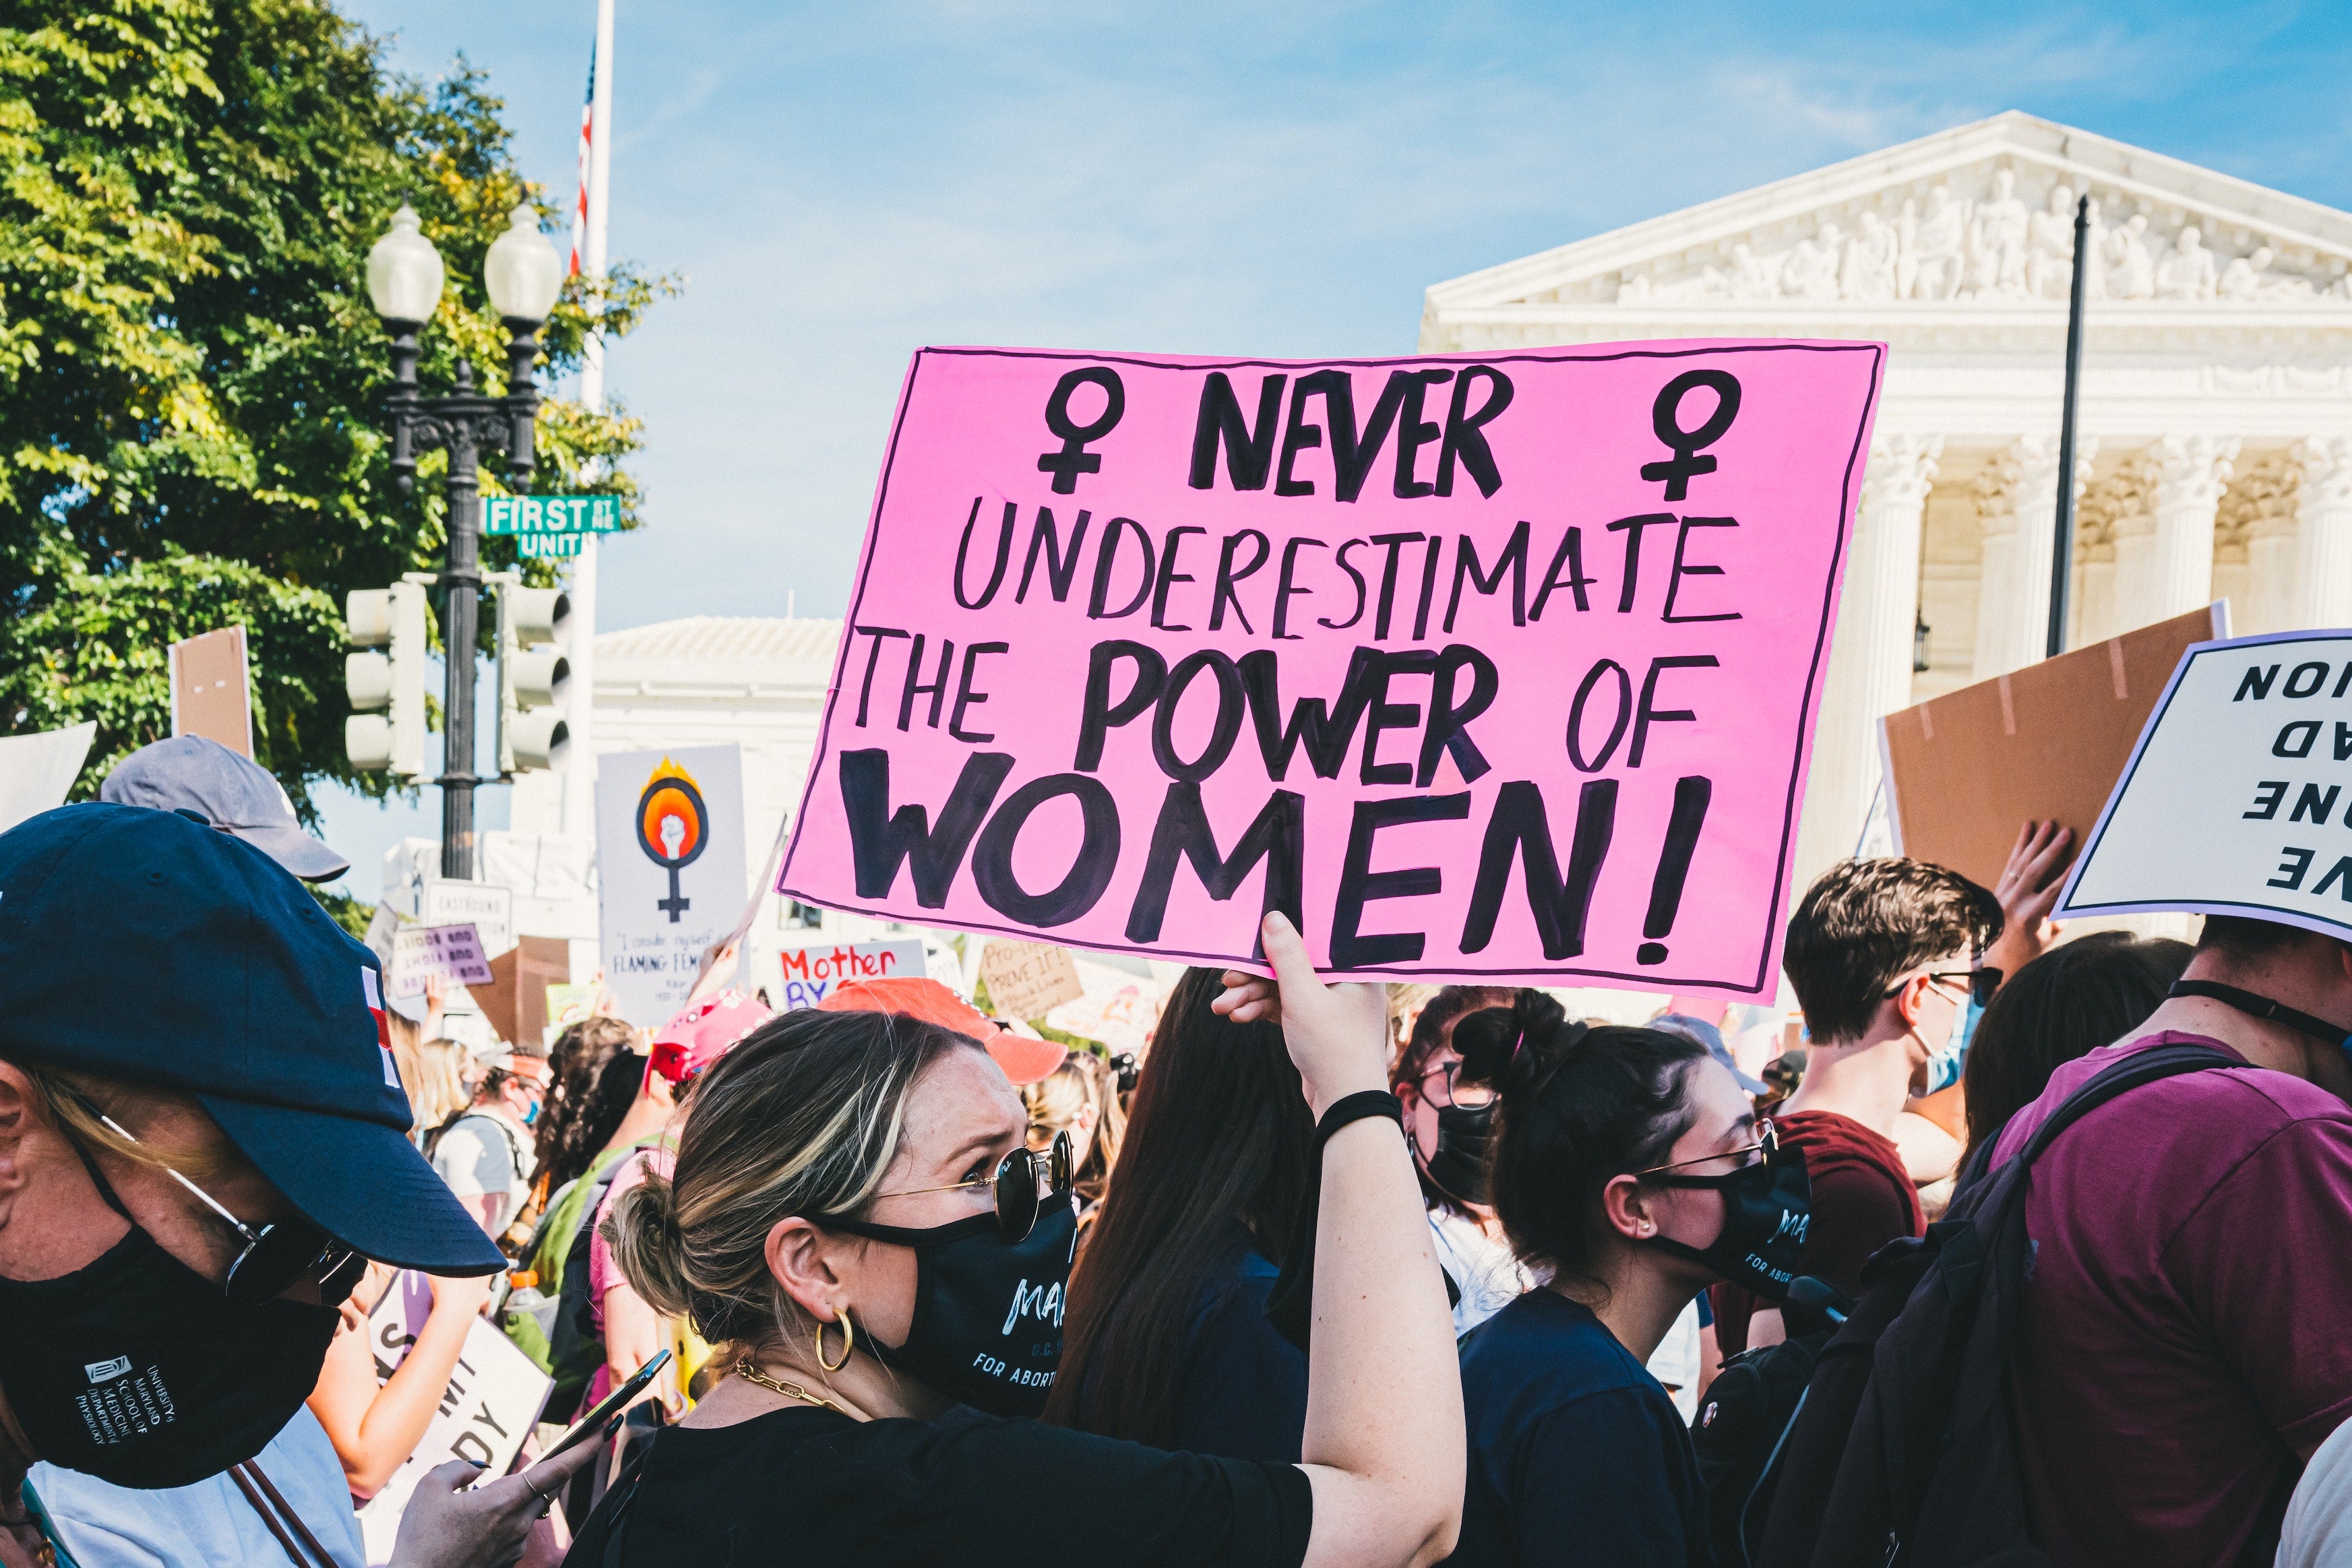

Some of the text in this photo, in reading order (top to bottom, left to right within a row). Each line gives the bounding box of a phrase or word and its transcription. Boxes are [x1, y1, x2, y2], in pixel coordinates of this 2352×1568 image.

[1188, 365, 1514, 503] NEVER
[491, 499, 613, 532] FIRST ST
[521, 533, 580, 556] UNIT
[954, 497, 1743, 641] UNDERESTIMATE
[855, 625, 1720, 788] THE POWER OF
[2241, 782, 2352, 830] NE
[840, 748, 1712, 969] WOMEN!
[613, 953, 701, 973] FLAMING FEM
[780, 945, 896, 981] Mother
[786, 981, 827, 1010] BY
[1745, 1253, 1768, 1272] FOR
[973, 1352, 1006, 1377] FOR
[87, 1388, 117, 1438] DEPARTMENT
[102, 1388, 131, 1437] MEDICINE
[116, 1379, 148, 1434] SCHOOL OF
[133, 1377, 160, 1426] MARYLAND
[146, 1365, 175, 1415] UNIVERSITY
[75, 1395, 105, 1445] PHYSIOLOGY
